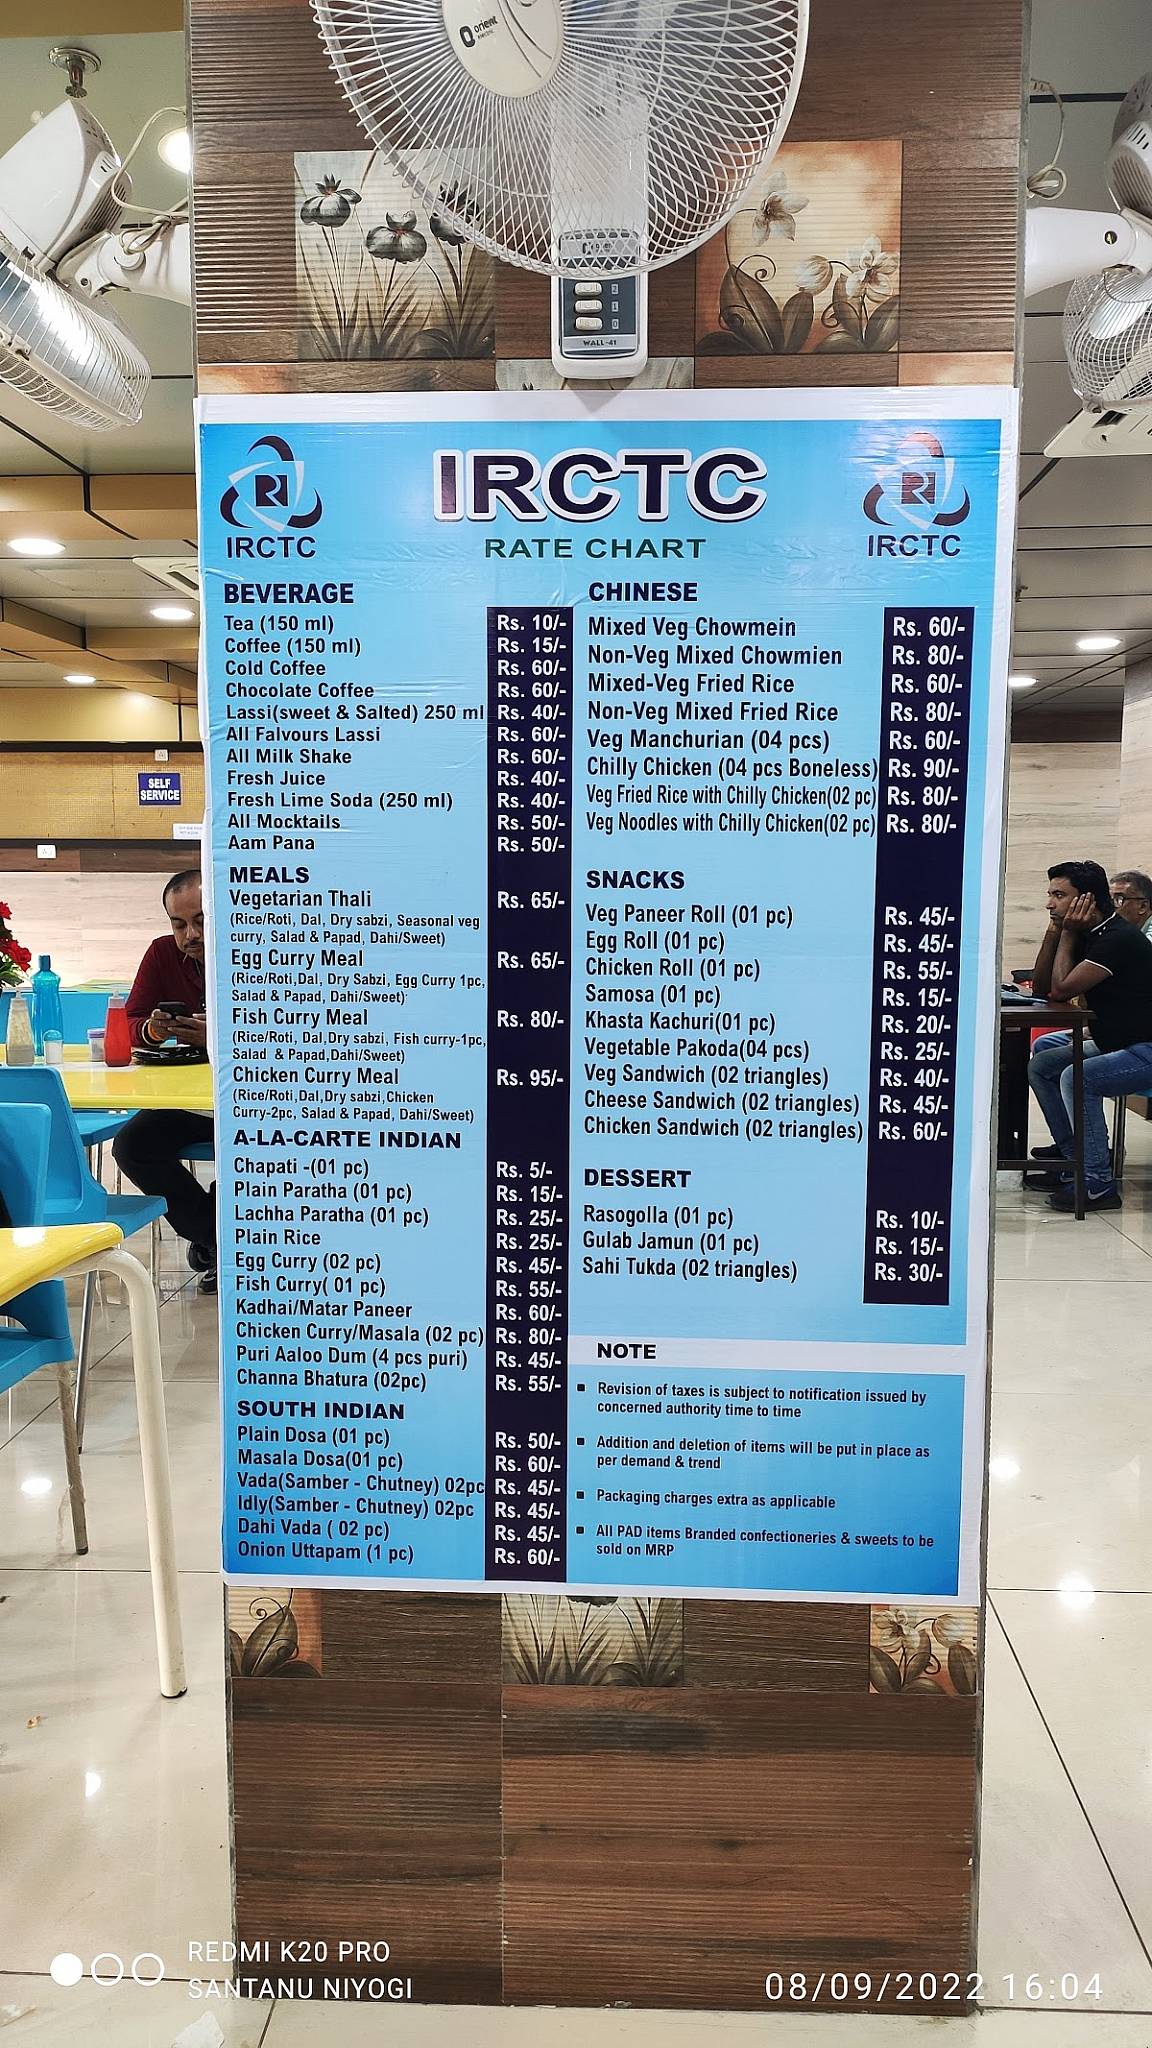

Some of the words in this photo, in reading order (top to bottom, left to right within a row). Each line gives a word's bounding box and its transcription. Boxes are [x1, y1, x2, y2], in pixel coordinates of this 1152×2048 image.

[435, 449, 766, 521] IRCTC
[227, 536, 316, 558] IRCTC
[485, 539, 573, 558] RATE
[586, 538, 706, 558] CHART
[868, 535, 961, 556] IRCTC
[224, 583, 354, 603] BEVERAGE
[589, 582, 697, 601] CHINESE
[224, 615, 254, 630] Tea
[260, 615, 298, 635] (150
[305, 615, 333, 635] ml)
[498, 615, 524, 630] Rs.
[533, 614, 566, 630] 10/-
[589, 616, 645, 635] Mixed
[653, 617, 688, 641] Veg
[696, 617, 795, 636] Chowmein
[893, 617, 921, 636] Rs.
[929, 616, 965, 636] 60/-
[588, 701, 668, 725] Non-Veg
[676, 701, 732, 720] Mixed
[741, 702, 788, 720] Fried
[796, 702, 838, 721] Rice
[891, 702, 918, 721] Rs.
[926, 702, 961, 721] 80/-
[226, 727, 248, 741] All
[256, 727, 328, 741] Falvours
[336, 727, 380, 741] Lassi
[498, 727, 524, 742] Rs.
[532, 726, 566, 742] 60/-
[148, 778, 171, 789] SELF
[140, 789, 180, 801] SERVICE
[586, 812, 613, 835] Veg
[619, 812, 677, 831] Noodles
[683, 813, 713, 831] with
[719, 813, 760, 836] Chilly
[766, 813, 847, 837] Chicken(02
[853, 814, 875, 837] pc)
[887, 814, 914, 833] Rs.
[922, 814, 956, 833] 80/-
[230, 867, 309, 883] MEALS
[586, 870, 684, 889] SNACKS
[229, 889, 322, 910] Vegetarian
[328, 890, 371, 907] Thali
[498, 891, 524, 908] Rs.
[531, 892, 565, 909] 65/-
[230, 913, 295, 928] (Rice/Roti,
[301, 913, 325, 927] Dal,
[331, 913, 352, 929] Dry
[357, 914, 392, 928] sabzi,
[397, 914, 453, 926] Seasonal
[458, 918, 479, 930] veg
[231, 933, 265, 945] curry,
[271, 930, 305, 942] Salad
[310, 931, 319, 943] &
[324, 931, 365, 946] Papad,
[371, 931, 445, 947] Dahi/Sweet)
[586, 984, 654, 1002] Samosa
[661, 985, 686, 1007] (01
[695, 985, 720, 1008] pc)
[883, 988, 910, 1006] Rs.
[918, 988, 952, 1007] 15/-
[584, 1037, 670, 1059] Vegetable
[677, 1038, 767, 1062] Pakoda(04
[773, 1040, 809, 1063] pcs)
[881, 1042, 908, 1060] Rs.
[915, 1042, 950, 1061] 25/-
[233, 1066, 298, 1082] Chicken
[305, 1067, 351, 1087] Curry
[358, 1067, 398, 1084] Meal
[497, 1069, 523, 1086] Rs.
[530, 1069, 563, 1086] 95/-
[233, 1089, 346, 1105] (Rice/Roti,Dal,Dry
[350, 1091, 433, 1104] sabzi,Chicken
[233, 1130, 371, 1147] A-LA-CARTE
[380, 1132, 460, 1148] INDIAN
[585, 1169, 691, 1188] DESSERT
[584, 1205, 668, 1227] Rasogolla
[675, 1206, 699, 1228] (01
[708, 1208, 733, 1229] pc)
[876, 1210, 903, 1228] Rs.
[911, 1211, 944, 1229] 10/-
[583, 1256, 619, 1274] Sahi
[626, 1257, 675, 1275] Tukda
[682, 1259, 709, 1280] (02
[715, 1260, 797, 1283] triangles)
[875, 1262, 901, 1281] Rs.
[909, 1263, 943, 1282] 30/-
[237, 1298, 348, 1316] Kadhai/Matar
[354, 1301, 412, 1318] Paneer
[496, 1304, 521, 1320] Rs.
[529, 1304, 562, 1321] 60/-
[598, 1343, 656, 1359] NOTE
[237, 1369, 297, 1385] Channa
[305, 1370, 367, 1387] Bhatura
[374, 1371, 426, 1392] (02pc)
[496, 1374, 521, 1391] Rs.
[529, 1375, 561, 1392] 55/-
[598, 1382, 651, 1395] Revision
[656, 1383, 668, 1395] of
[672, 1384, 705, 1397] taxes
[710, 1385, 719, 1397] is
[724, 1385, 769, 1401] subject
[773, 1387, 784, 1399] to
[789, 1387, 861, 1401] notification
[866, 1389, 907, 1402] issued
[912, 1390, 927, 1406] by
[238, 1400, 315, 1417] SOUTH
[325, 1402, 404, 1419] INDIAN
[598, 1402, 662, 1413] concerned
[666, 1402, 721, 1418] authority
[725, 1403, 753, 1416] time
[757, 1405, 768, 1416] to
[773, 1405, 801, 1417] time
[238, 1449, 297, 1465] Masala
[304, 1450, 369, 1471] Dosa(01
[378, 1452, 402, 1472] pc)
[496, 1455, 521, 1471] Rs.
[528, 1456, 561, 1472] 60/-
[597, 1489, 660, 1506] Packaging
[664, 1491, 713, 1507] charges
[717, 1494, 747, 1505] extra
[752, 1497, 765, 1506] as
[770, 1495, 835, 1510] applicable
[596, 1525, 612, 1536] All
[618, 1525, 642, 1537] PAD
[647, 1526, 680, 1539] items
[685, 1527, 736, 1540] Branded
[740, 1529, 836, 1544] confectioneries
[841, 1532, 850, 1544] &
[854, 1534, 898, 1546] sweets
[902, 1535, 914, 1546] to
[919, 1534, 934, 1547] be
[238, 1541, 285, 1557] Onion
[292, 1542, 360, 1562] Uttapam
[367, 1544, 380, 1563] (1
[389, 1545, 413, 1565] pc)
[495, 1548, 520, 1564] Rs.
[528, 1549, 560, 1565] 60/-
[597, 1543, 622, 1554] sold
[627, 1546, 641, 1555] on
[646, 1544, 674, 1556] MRP
